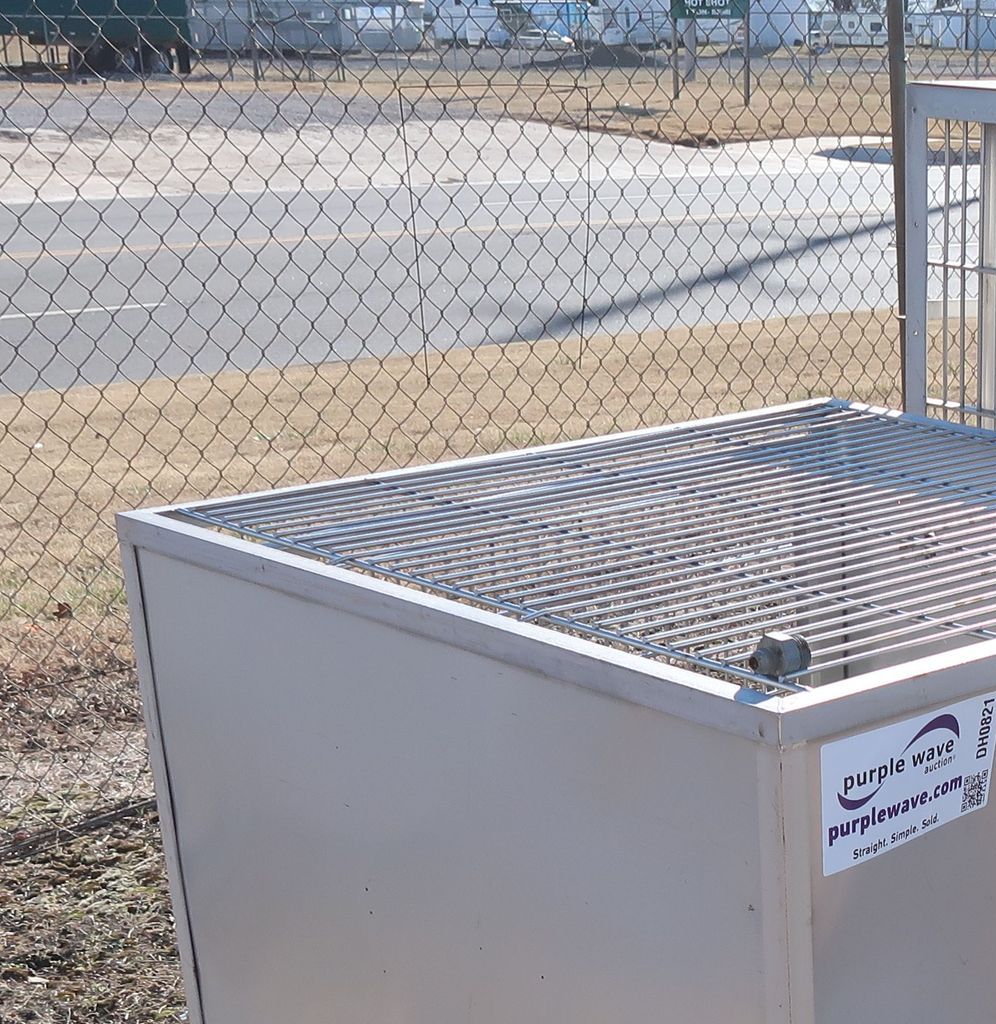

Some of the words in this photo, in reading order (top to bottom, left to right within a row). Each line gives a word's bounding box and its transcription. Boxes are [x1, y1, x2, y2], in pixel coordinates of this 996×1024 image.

[976, 697, 995, 760] DH0821
[843, 757, 905, 795] purple
[912, 738, 954, 768] wave
[828, 775, 963, 847] purplewave.com
[852, 840, 888, 860] Straight.
[890, 826, 919, 845] Simple.
[921, 813, 940, 830] Sold.
